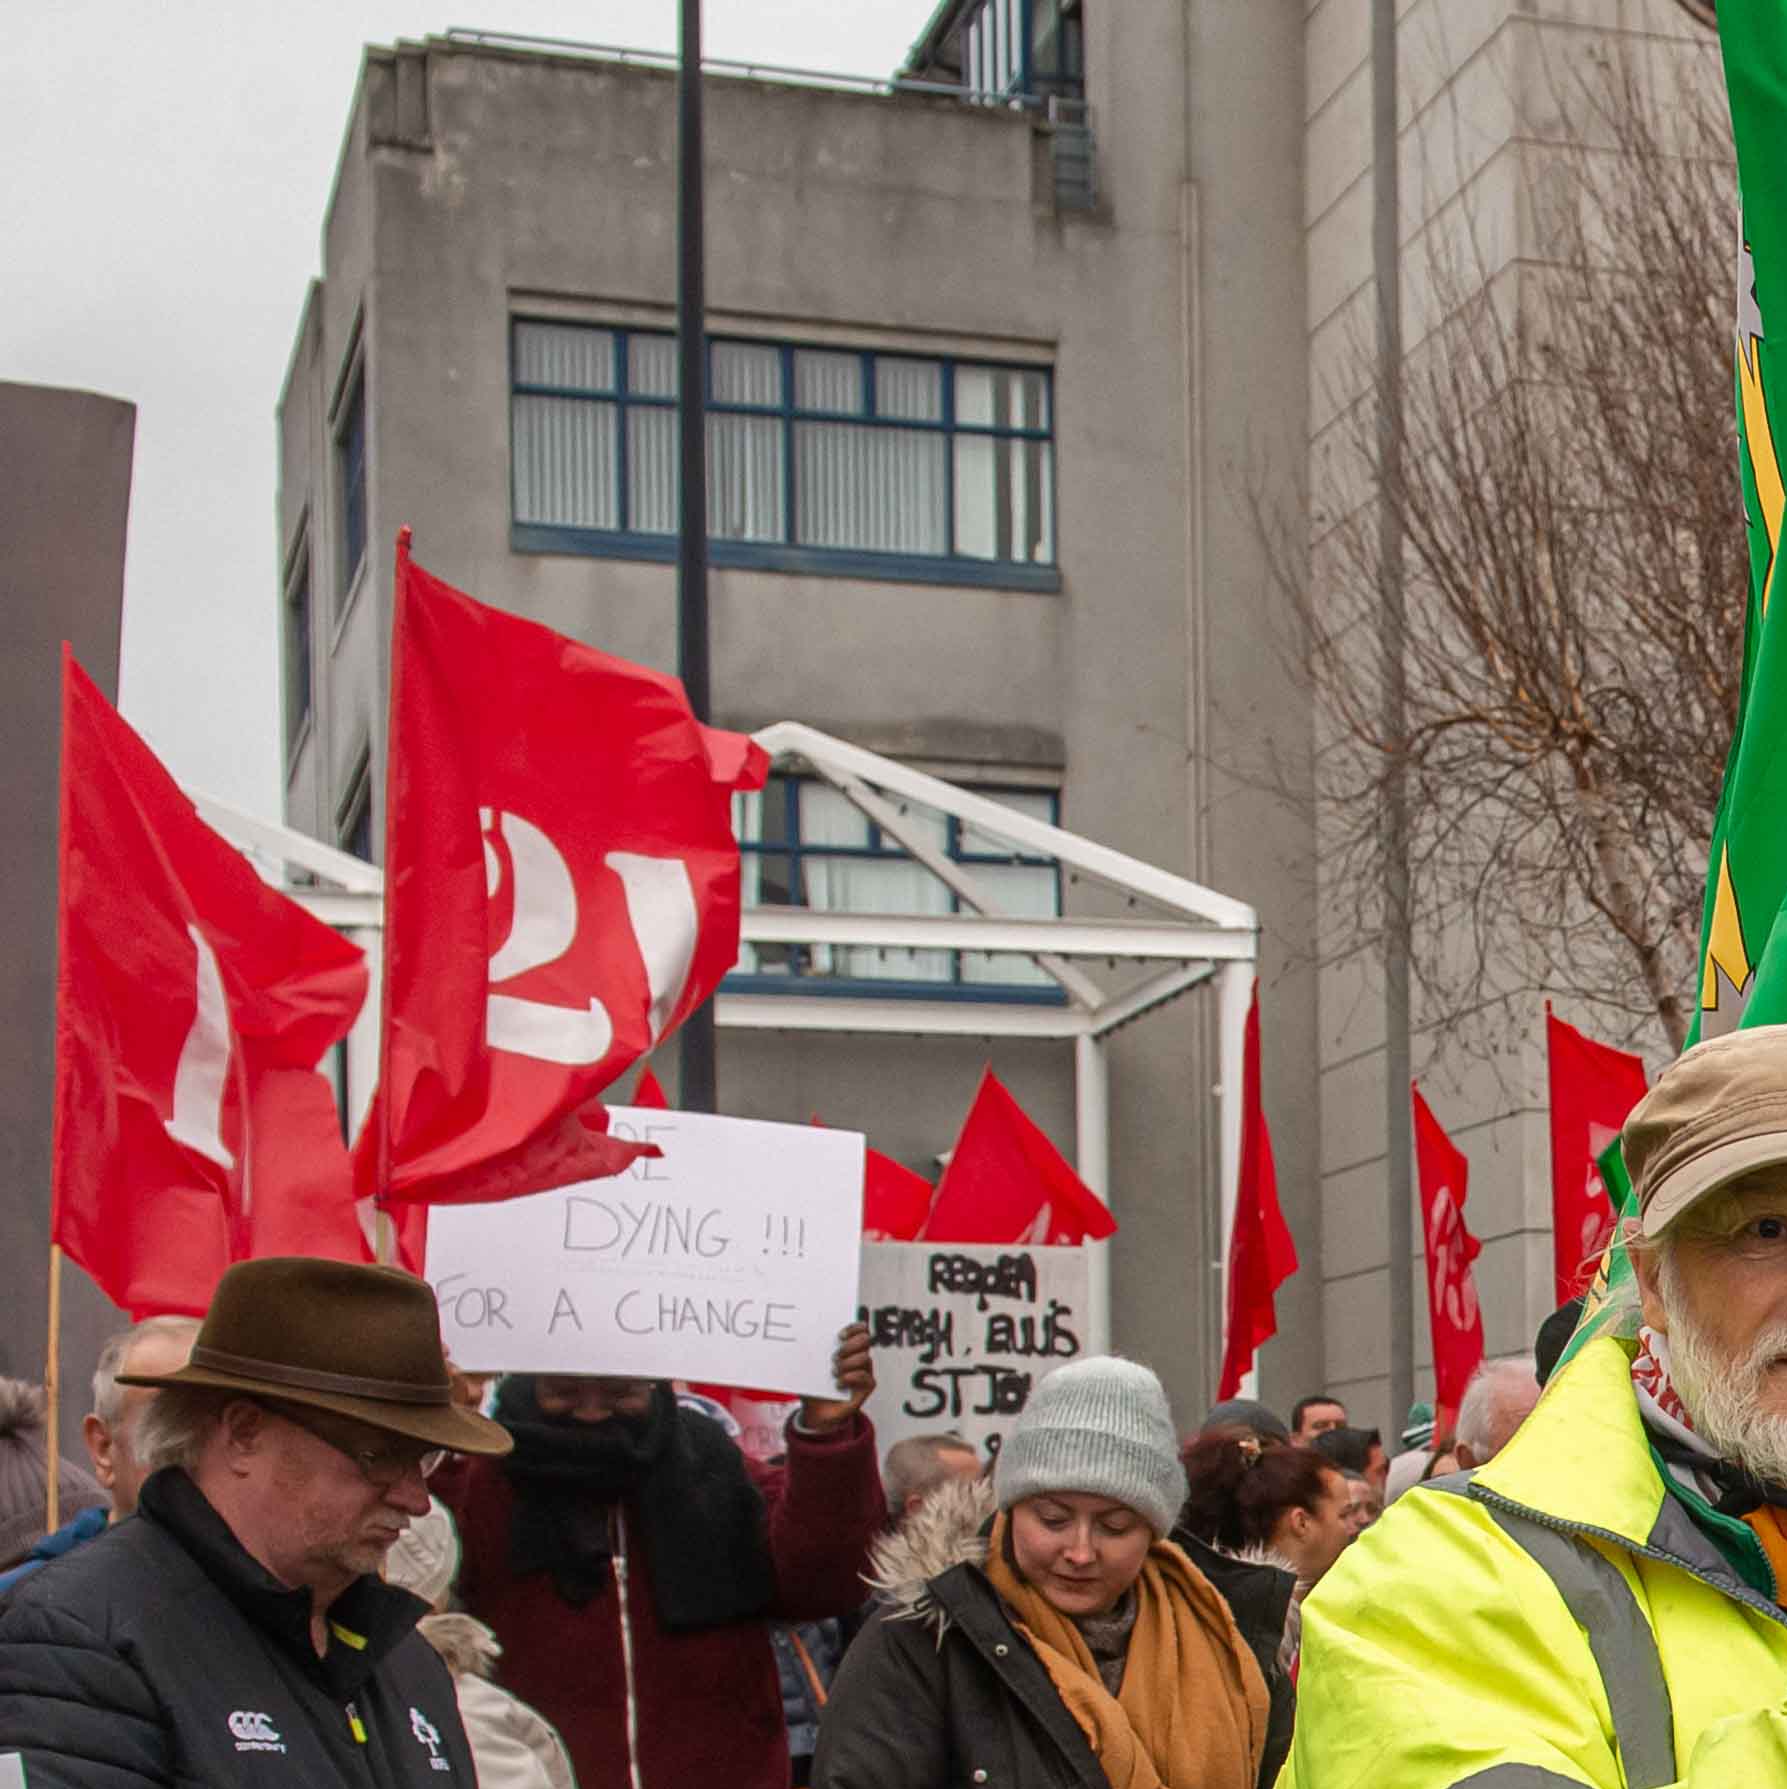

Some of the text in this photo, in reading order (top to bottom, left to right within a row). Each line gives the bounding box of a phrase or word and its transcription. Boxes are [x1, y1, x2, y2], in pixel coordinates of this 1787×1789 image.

[563, 1196, 730, 1259] DYING
[435, 1273, 799, 1342] FOR A CHANGE
